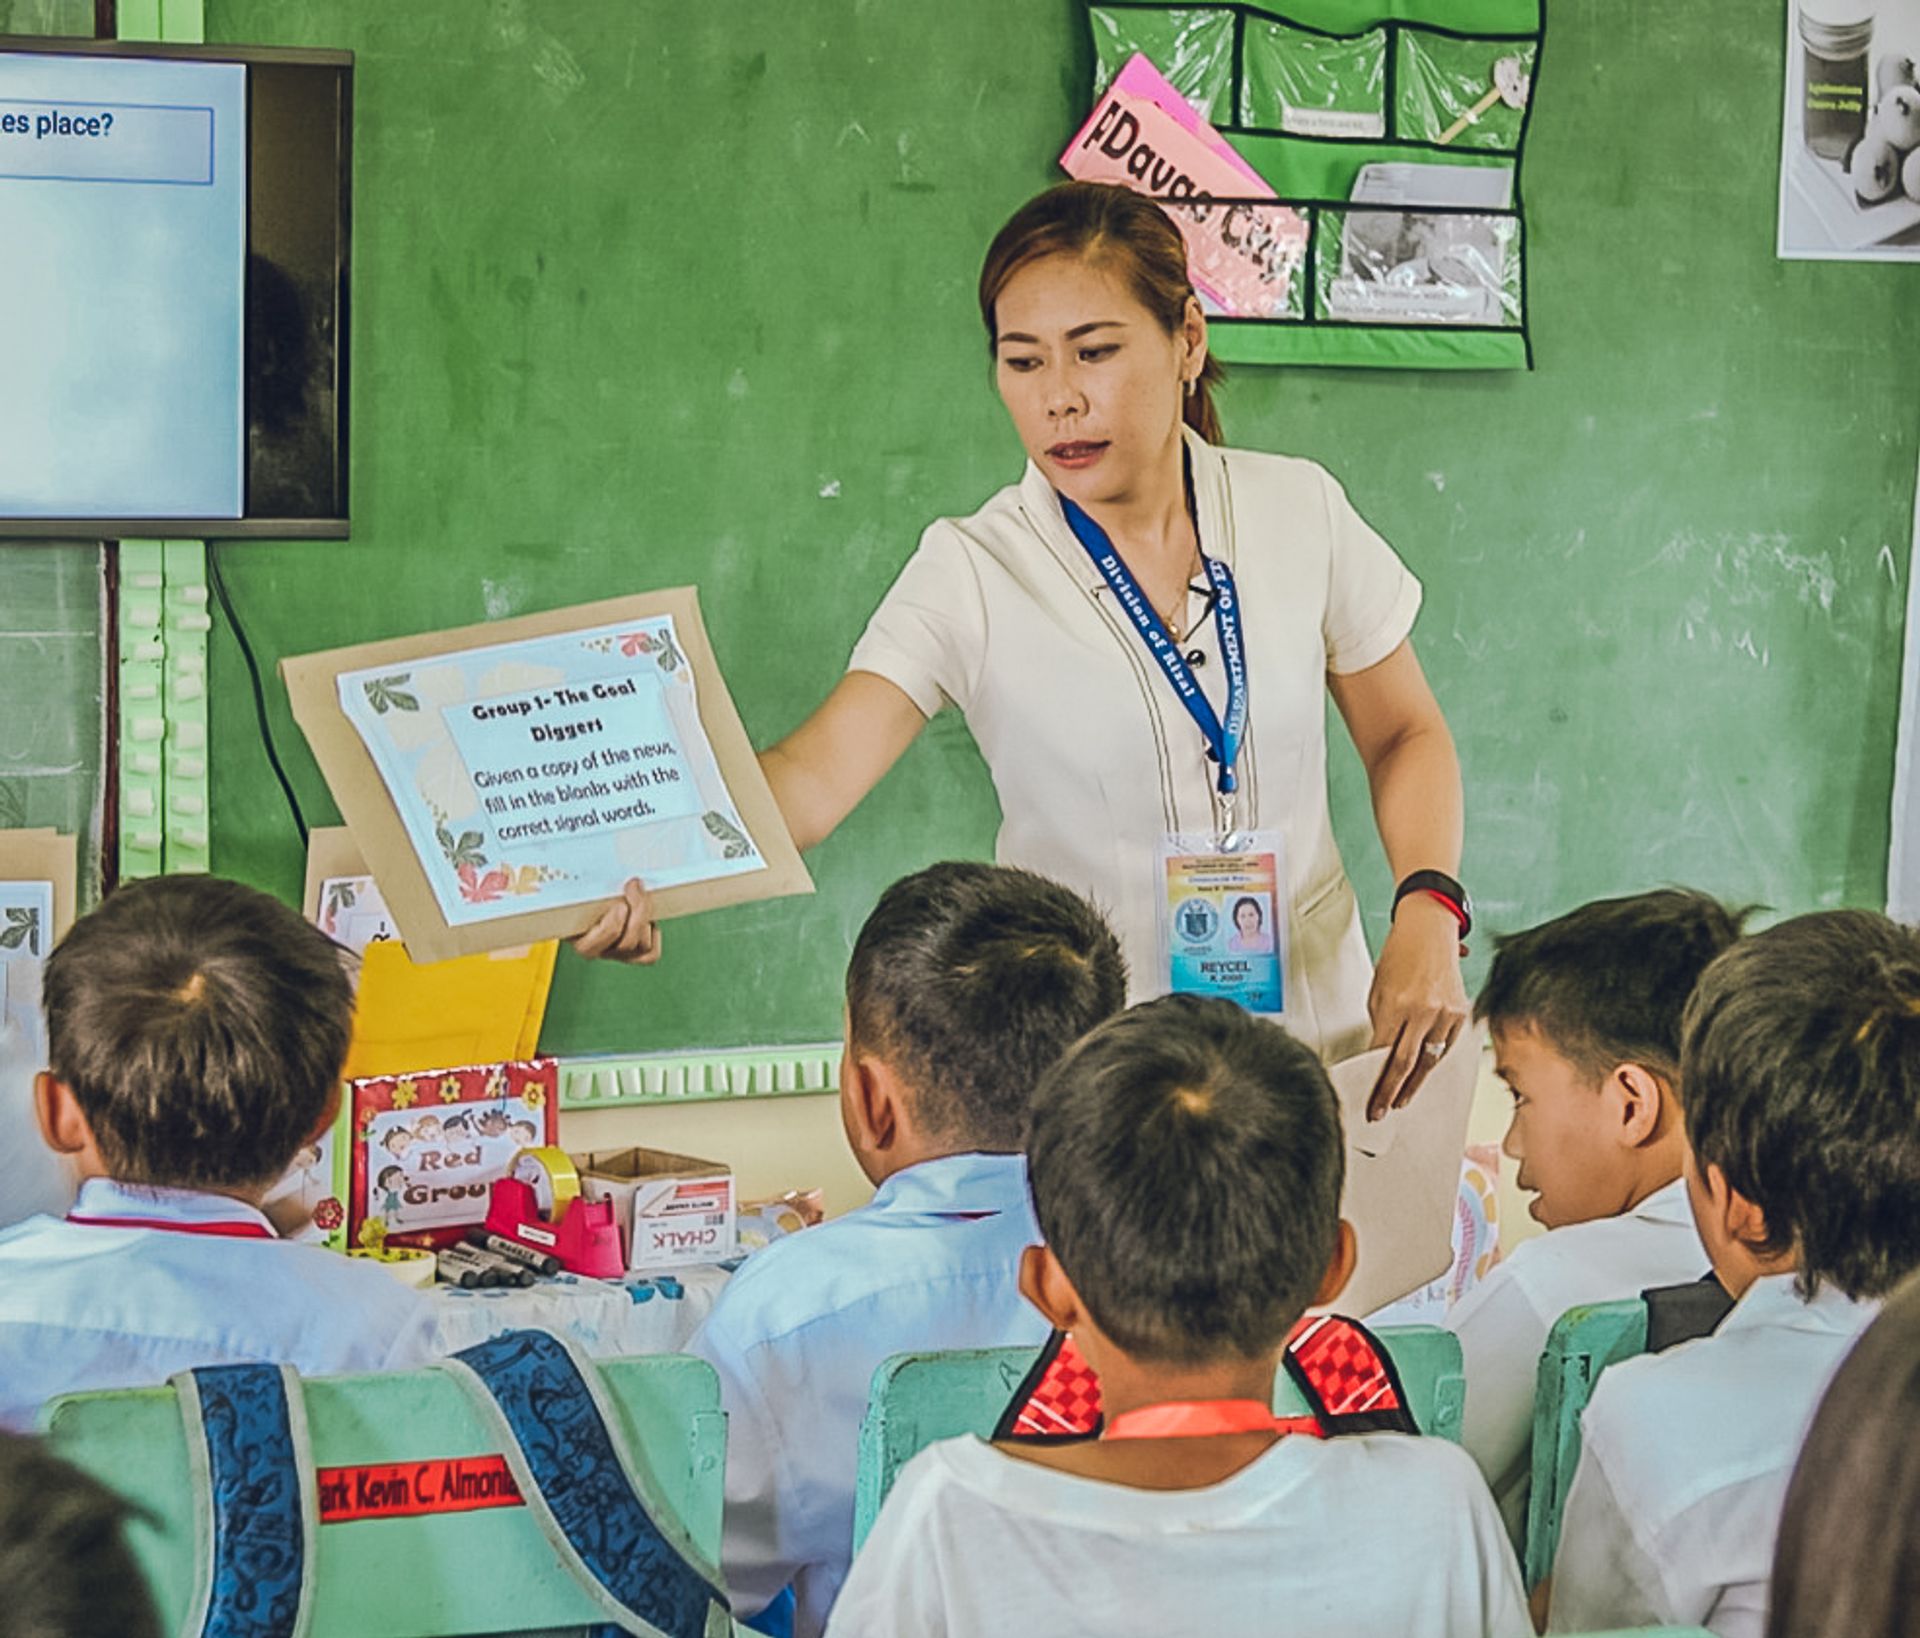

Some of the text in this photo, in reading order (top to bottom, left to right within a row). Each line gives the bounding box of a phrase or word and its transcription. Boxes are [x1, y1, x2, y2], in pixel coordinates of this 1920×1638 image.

[37, 111, 114, 139] place?
[1101, 554, 1196, 697] Division of Rizal
[1221, 613, 1246, 736] DEPARTMENT
[472, 700, 532, 720] Group
[553, 688, 590, 707] The
[592, 678, 637, 700] Goal
[530, 717, 604, 742] Diggers
[474, 768, 525, 789] Given
[527, 765, 540, 779] a
[541, 759, 580, 778] copy
[582, 751, 600, 771] of
[601, 748, 631, 767] the
[485, 766, 681, 815] fill in the blanks with the
[498, 799, 656, 841] correct signal words.
[419, 1145, 482, 1172] Red
[402, 1182, 493, 1206] Grou
[652, 1228, 716, 1250] CHALK
[355, 1469, 410, 1510] Kevin
